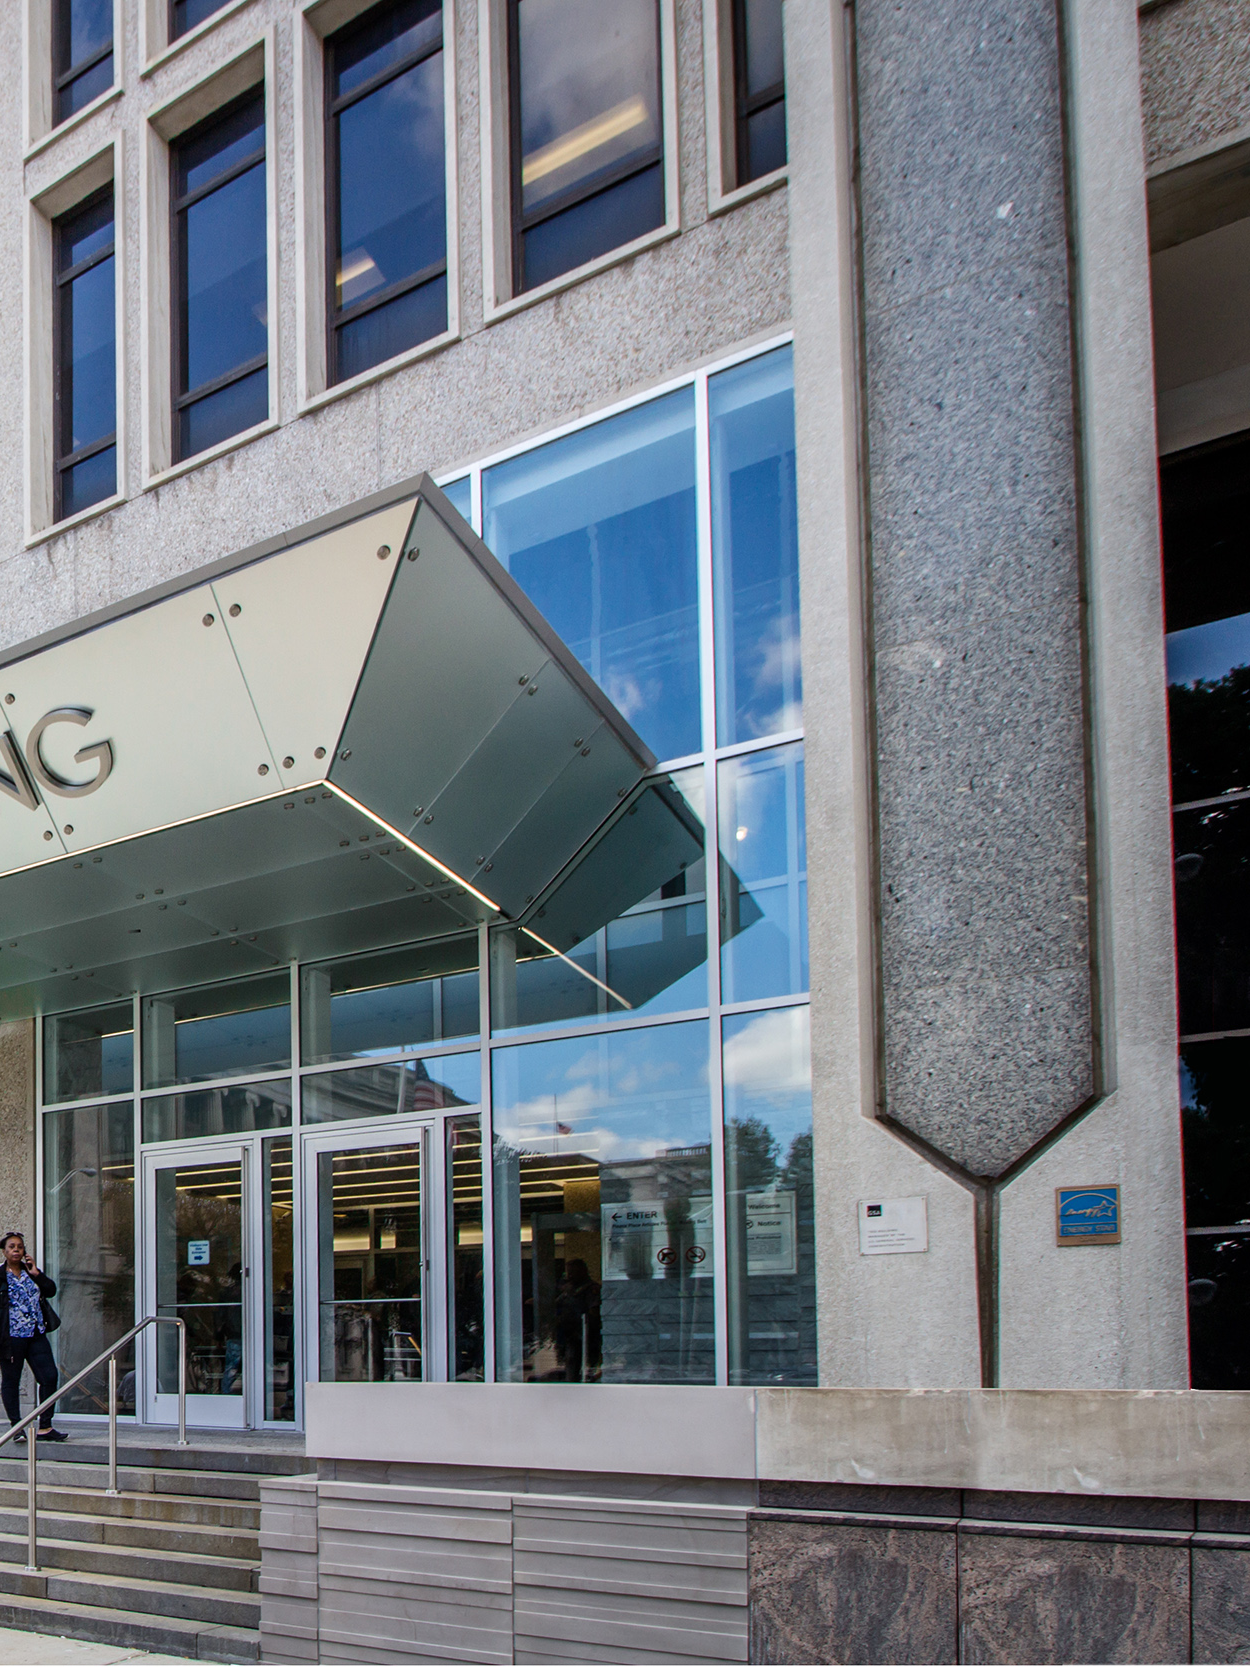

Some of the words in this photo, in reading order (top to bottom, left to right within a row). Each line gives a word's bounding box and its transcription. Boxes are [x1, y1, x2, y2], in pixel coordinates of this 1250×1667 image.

[626, 1210, 658, 1220] ENTER
[1063, 1226, 1093, 1234] ENERGY
[1095, 1224, 1115, 1232] STAR
